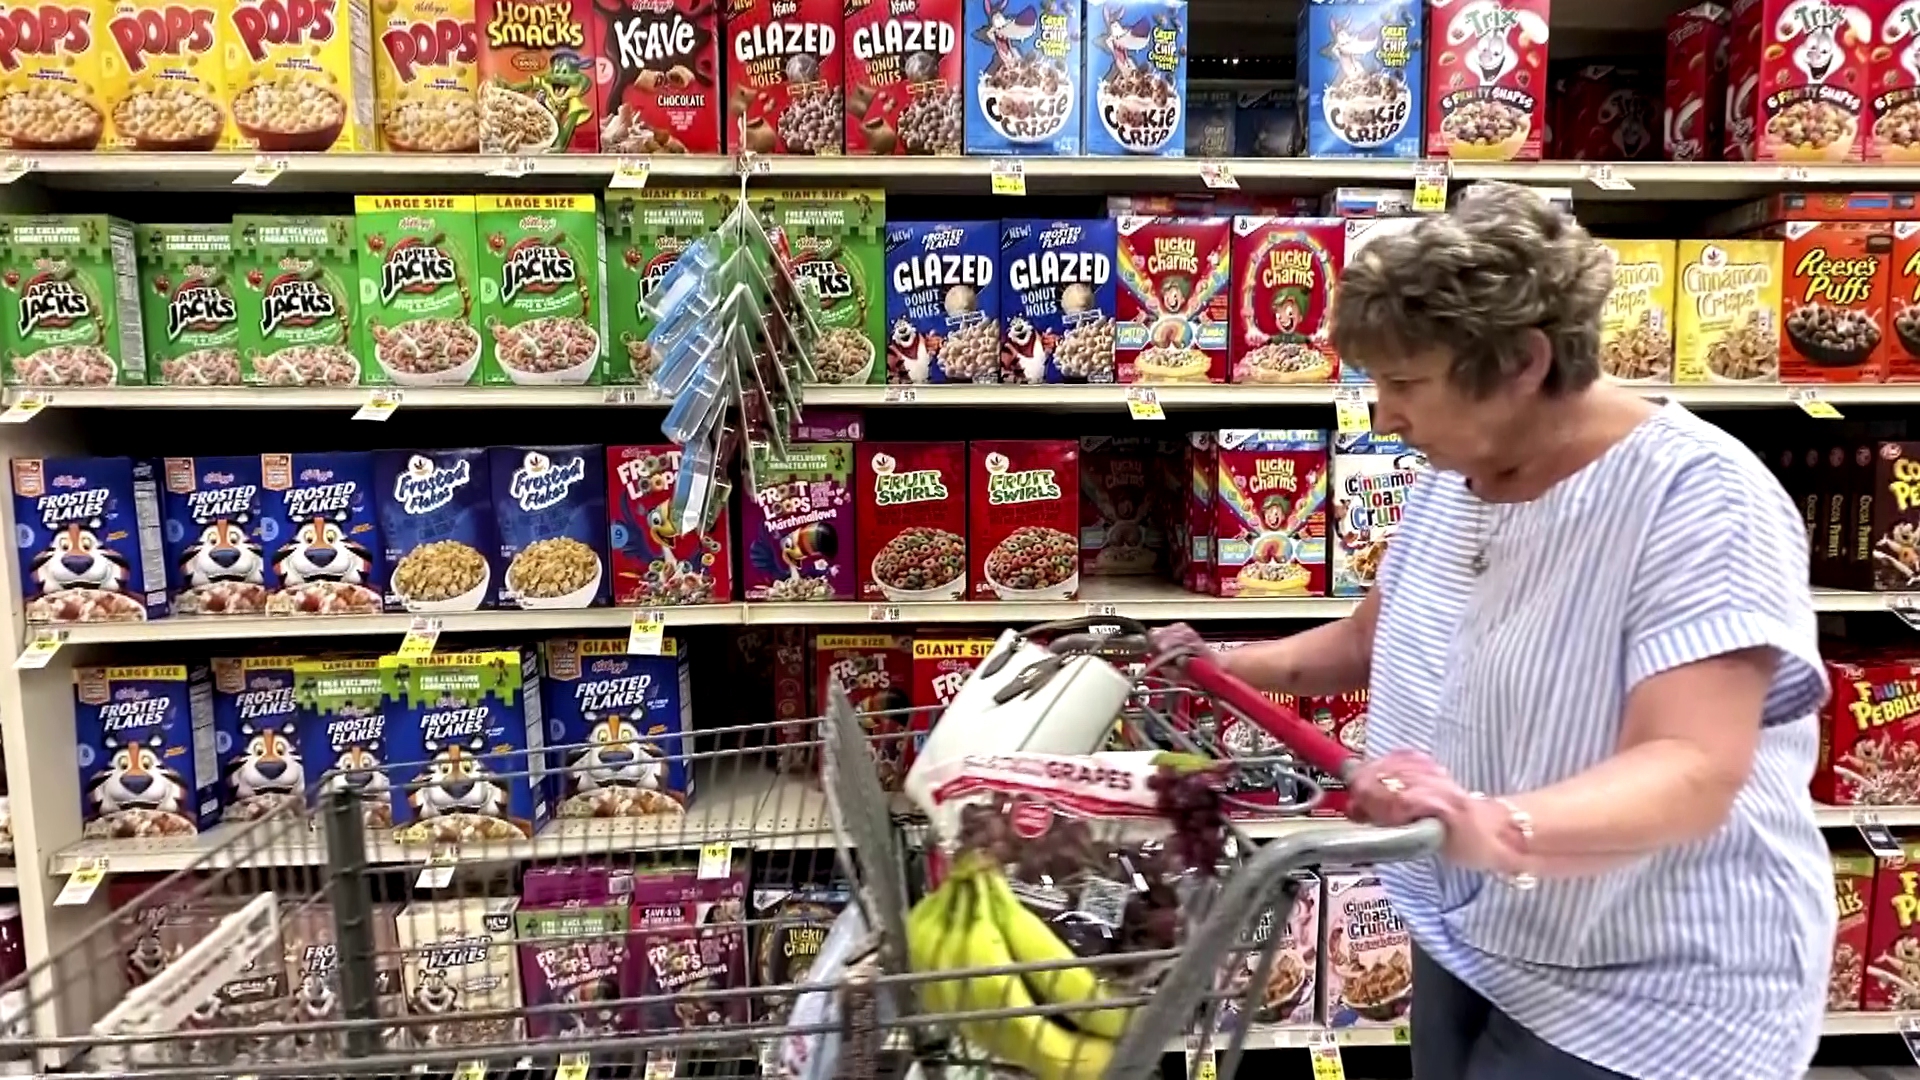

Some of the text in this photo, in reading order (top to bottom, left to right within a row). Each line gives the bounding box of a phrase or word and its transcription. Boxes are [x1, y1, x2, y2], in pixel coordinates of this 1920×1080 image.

[496, 0, 572, 27] HONEY
[1465, 7, 1518, 37] Trix
[1794, 3, 1846, 34] Trix
[109, 8, 215, 74] POPS
[231, 0, 336, 64] POPS
[488, 20, 583, 47] SMACKS
[735, 20, 836, 62] GLAZED
[853, 19, 955, 60] GLAZED
[381, 21, 478, 84] POPS
[1155, 42, 1177, 56] CHIP
[1382, 40, 1408, 51] CHIP
[746, 57, 781, 75] DONUT
[865, 56, 900, 74] DONUT
[751, 73, 782, 87] HOLES
[869, 72, 901, 87] HOLES
[657, 95, 705, 106] CHOCOLATE
[1442, 87, 1534, 109] 6 FRUITY SHAPES
[1767, 85, 1861, 110] 6 FRUITY SHAPES
[375, 200, 454, 208] LARGE SIZE
[496, 199, 574, 208] LARGE SIZE
[641, 189, 707, 198] GIANT SIZE
[782, 189, 847, 198] GIANT SIZE
[893, 228, 914, 242] NEW!
[922, 229, 963, 244] FROSTED
[1009, 225, 1032, 238] NEW!
[1040, 226, 1081, 242] FROSTED
[1043, 236, 1078, 248] FLAKES
[514, 247, 557, 262] APPLE
[925, 238, 961, 250] FLAKES
[394, 248, 437, 263] APPLE
[1796, 250, 1878, 278] Reese's
[796, 261, 834, 276] APPLE
[893, 253, 993, 293] GLAZED
[1010, 251, 1110, 291] GLAZED
[1686, 264, 1768, 292] Cinnamon
[28, 282, 72, 297] APPLE
[273, 281, 315, 297] APPLE
[382, 259, 454, 302] JACKS
[502, 259, 574, 301] JACKS
[179, 287, 218, 302] APPLE
[905, 290, 939, 306] DONUT
[1021, 287, 1056, 305] DONUT
[1804, 278, 1870, 304] Puffs
[20, 294, 86, 333] JACKS
[263, 294, 332, 334] JACKS
[909, 303, 940, 318] HOLES
[1026, 302, 1057, 316] HOLES
[1699, 290, 1755, 317] Crisps
[170, 299, 235, 339] JACKS
[399, 461, 467, 497] Frosted
[514, 458, 583, 496] Frosted
[618, 452, 682, 485] FROOT
[878, 473, 939, 491] FRUIT
[991, 472, 1053, 490] FRUIT
[1345, 472, 1416, 495] Cinnamo
[38, 489, 109, 511] FROSTED
[188, 485, 257, 507] FROSTED
[284, 481, 356, 505] FROSTED
[409, 489, 451, 512] Flakes
[524, 486, 567, 509] Flakes
[757, 481, 808, 507] FROOT
[877, 486, 947, 505] SWIRLS
[989, 485, 1060, 505] SWIRLS
[1363, 487, 1411, 509] Toast
[43, 504, 103, 523] FLAKES
[192, 500, 250, 518] FLAKES
[288, 496, 349, 516] FLAKES
[763, 497, 811, 519] LOOPS
[1353, 505, 1403, 528] Crun
[764, 509, 837, 532] Marshmallows
[614, 528, 623, 539] 9
[823, 637, 885, 647] LARGE SIZE
[916, 644, 965, 656] GIANT
[246, 658, 286, 668] LARGE
[322, 661, 377, 671] LARGE SIZE
[416, 655, 482, 666] GIANT SIZE
[829, 653, 888, 680] FROOT
[110, 666, 180, 678] LARGE SIZE
[840, 670, 890, 694] LOOPS
[235, 687, 297, 708] FROSTE
[575, 675, 651, 699] FROSTED
[1853, 679, 1918, 702] FRUITY
[99, 698, 169, 719] FROSTED
[240, 700, 296, 719] FLAKES
[581, 689, 645, 711] FLAKES
[104, 713, 163, 731] FLAKES
[327, 715, 385, 736] FROSTED
[421, 707, 489, 729] FROSTED
[332, 728, 382, 745] FLAKES
[425, 721, 483, 740] FLAKES
[1048, 761, 1131, 790] GRAPES
[486, 917, 508, 927] NEW
[1357, 907, 1394, 925] Toast
[1350, 918, 1404, 938] Crunch
[428, 948, 487, 969] FLAKES
[647, 939, 698, 966] FROOT
[653, 954, 702, 977] LOOPS
